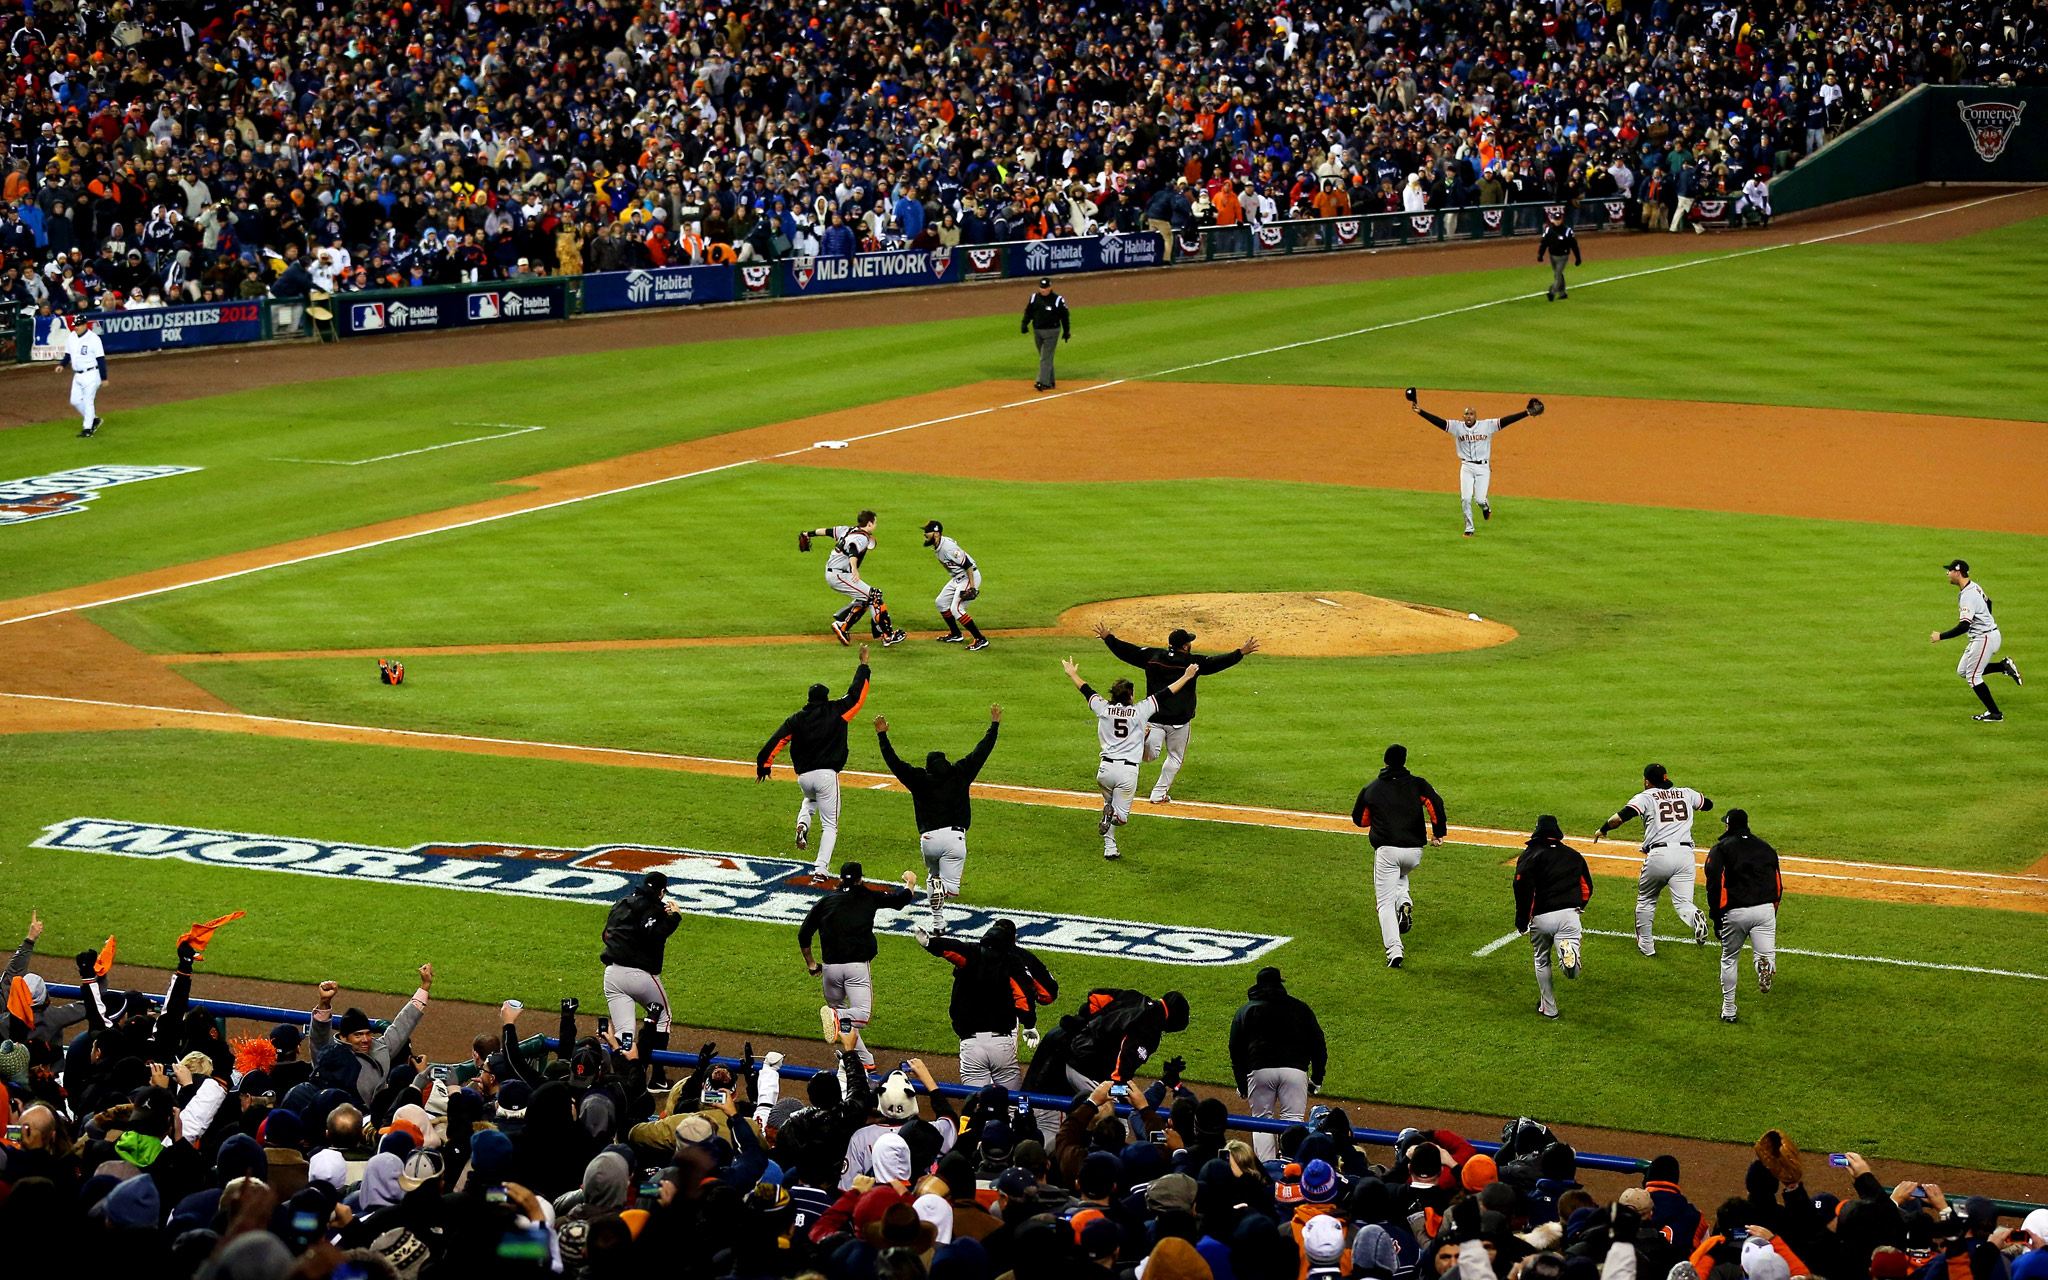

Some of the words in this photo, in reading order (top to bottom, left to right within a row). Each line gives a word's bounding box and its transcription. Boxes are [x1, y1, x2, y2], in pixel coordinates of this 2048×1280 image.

[1050, 245, 1082, 260] Habitat
[1125, 239, 1156, 254] Habitat
[817, 259, 848, 281] MLB
[852, 253, 928, 278] NETWORK
[655, 275, 693, 291] Habitat
[523, 296, 550, 308] Habitat
[409, 305, 438, 317] Habitat
[106, 314, 164, 333] WORLD
[164, 308, 220, 328] SERIES
[220, 305, 258, 323] 2012
[161, 328, 182, 342] FOX
[1107, 707, 1136, 717] THERIOT
[1113, 718, 1129, 739] 5
[1652, 790, 1684, 801] SANCHEZ
[1659, 800, 1689, 823] 29
[58, 821, 630, 896] WORLD
